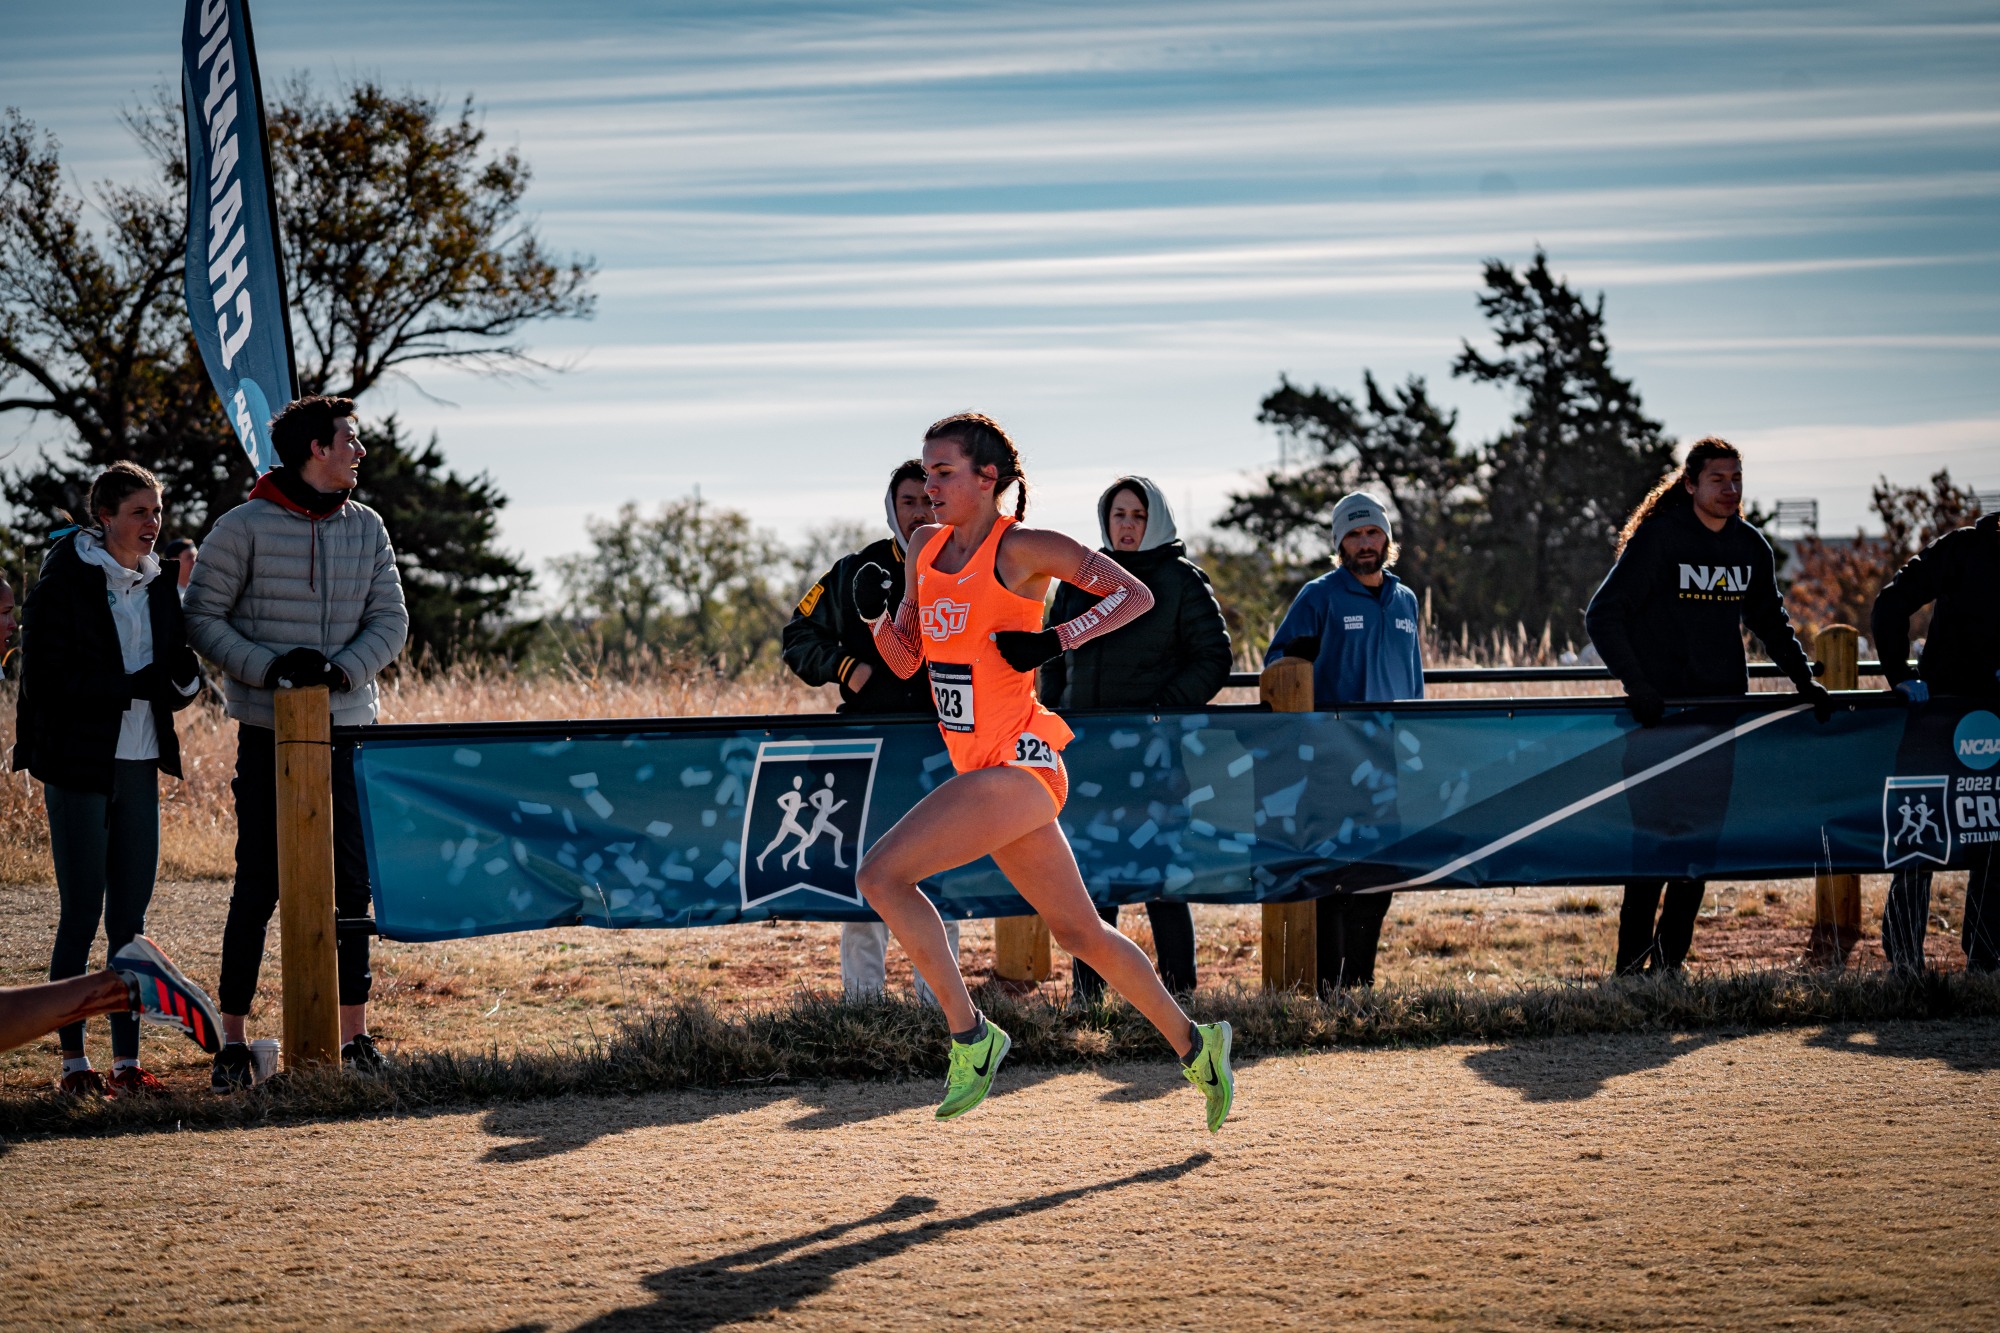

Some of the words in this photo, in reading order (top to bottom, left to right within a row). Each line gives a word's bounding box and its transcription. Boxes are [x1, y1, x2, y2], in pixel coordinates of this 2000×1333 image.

[1678, 563, 1752, 592] NAU
[1679, 592, 1713, 601] CROSS
[920, 598, 971, 642] OSU
[934, 686, 963, 719] 323
[1015, 738, 1053, 763] 323
[1956, 776, 1992, 792] 2022
[1955, 795, 2000, 829] CR
[1959, 831, 2000, 844] STILLW
